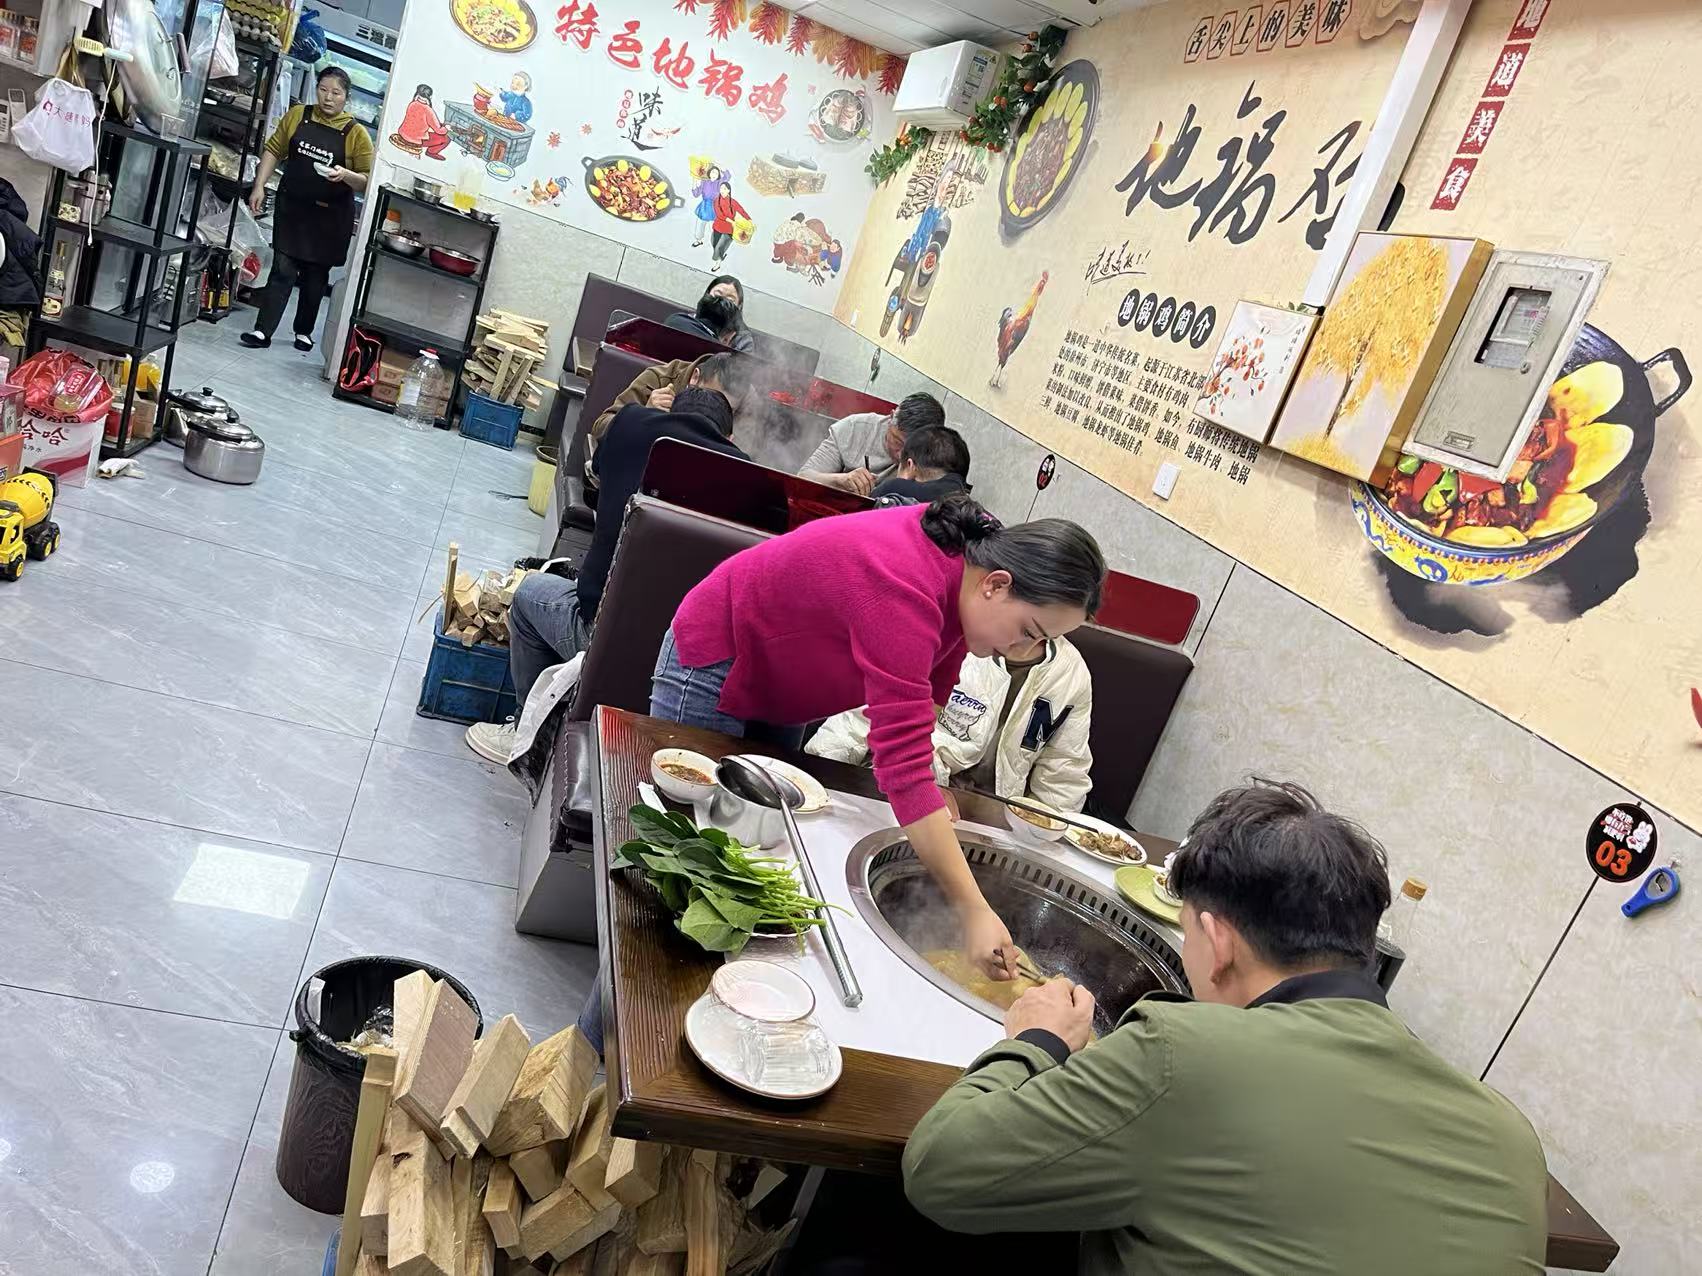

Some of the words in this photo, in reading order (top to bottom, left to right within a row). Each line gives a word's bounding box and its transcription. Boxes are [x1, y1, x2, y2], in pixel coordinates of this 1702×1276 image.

[1187, 0, 1348, 56] 舌尖上的美味
[554, 0, 790, 122] 特色地锅鸡
[620, 86, 663, 151] 味道
[1119, 291, 1213, 346] 地锅鸡简介
[1020, 695, 1074, 752] N
[1595, 840, 1632, 876] 03
